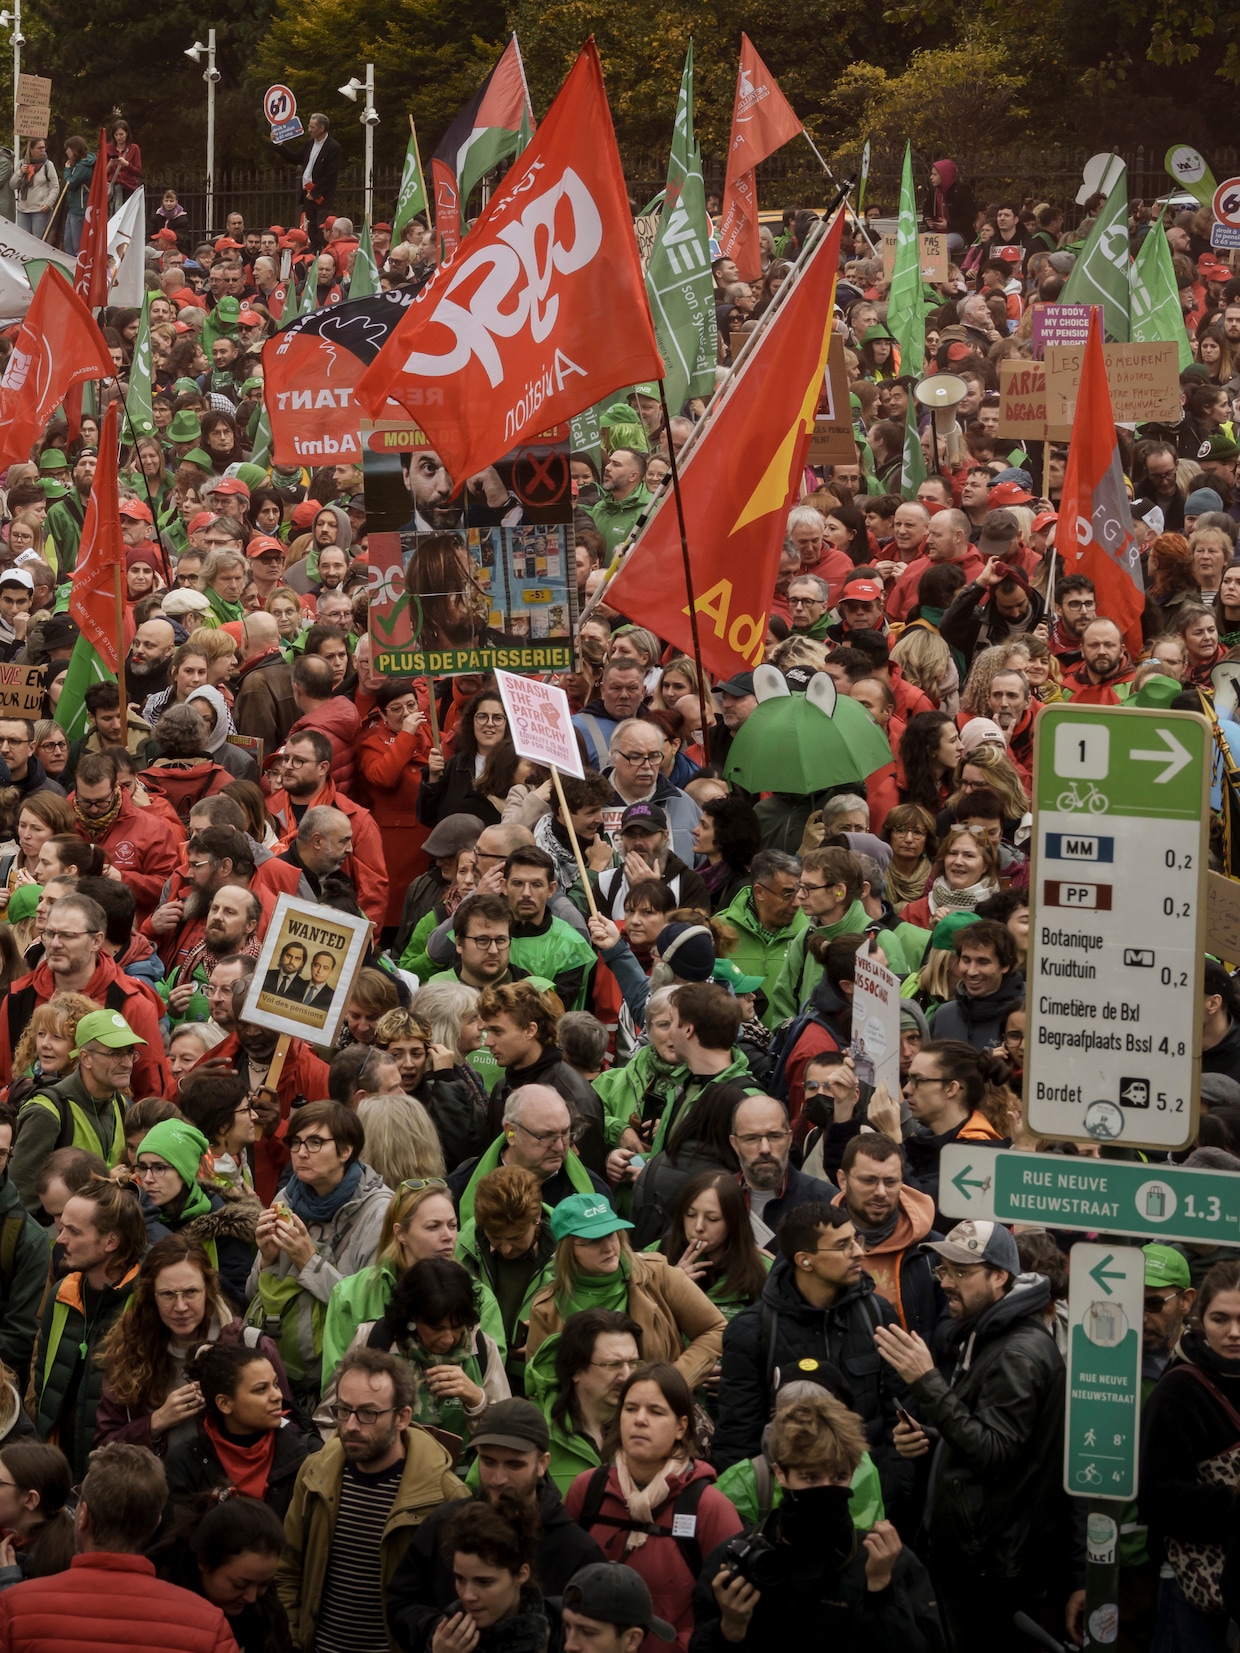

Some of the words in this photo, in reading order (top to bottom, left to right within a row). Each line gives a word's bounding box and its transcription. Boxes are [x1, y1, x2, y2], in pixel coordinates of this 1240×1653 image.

[1222, 193, 1240, 214] 6
[924, 236, 940, 247] PAS
[1216, 227, 1232, 235] droit
[1044, 318, 1058, 327] MY
[1059, 318, 1090, 327] CHOICE
[1047, 308, 1059, 316] MY
[1061, 307, 1087, 318] BODY,
[691, 312, 710, 370] syndicat
[1040, 329, 1054, 338] MY
[1051, 350, 1080, 375] LES
[1116, 349, 1173, 368] MEURENT
[1109, 390, 1128, 399] OTRE
[379, 652, 426, 672] PLUS
[430, 653, 453, 671] DE
[457, 648, 570, 669] PATISSERIE!
[26, 669, 47, 689] EN
[505, 677, 550, 701] SMASH
[24, 691, 44, 712] LUI
[508, 690, 533, 708] THE
[512, 704, 544, 724] PATRI
[520, 730, 550, 746] EQUALITY
[550, 740, 556, 750] IS
[558, 744, 568, 755] NOT
[531, 722, 566, 744] ARCHY
[520, 738, 530, 746] UP
[532, 740, 544, 750] FOR
[546, 746, 568, 761] DEBATE!
[1078, 740, 1086, 763] 1
[1066, 840, 1093, 856] MM
[1165, 849, 1192, 871] 0,2
[1066, 888, 1089, 902] PP
[1163, 897, 1190, 918] 0,2
[288, 920, 346, 950] WANTED
[1042, 926, 1104, 954] Botanique
[858, 956, 872, 974] VERS
[872, 964, 878, 977] LA
[886, 975, 894, 987] DES
[1040, 956, 1096, 980] Kruidtuin
[1161, 966, 1188, 988] 0,2
[262, 994, 274, 1004] Vol
[275, 998, 288, 1008] des
[290, 1004, 324, 1020] pensions
[1039, 996, 1097, 1019] Cimetière
[1102, 1002, 1117, 1020] de
[1120, 1002, 1140, 1022] Bxl
[1038, 1026, 1122, 1052] Begraafplaats
[1126, 1032, 1152, 1054] Bssl
[1158, 1036, 1185, 1058] 4,8
[1036, 1082, 1082, 1104] Bordet
[1022, 1170, 1053, 1188] RUE
[1058, 1174, 1108, 1192] NEUVE
[583, 1204, 608, 1218] CNE
[1010, 1193, 1120, 1218] NIEUWSTRAAT
[1184, 1194, 1221, 1222] 1.3
[1225, 1214, 1238, 1223] km
[1080, 1372, 1097, 1384] RUE
[1098, 1374, 1128, 1386] NEUVE
[1072, 1389, 1135, 1404] NIEUWSTRAAT
[1113, 1434, 1126, 1446] 8'
[1112, 1470, 1125, 1482] 4'
